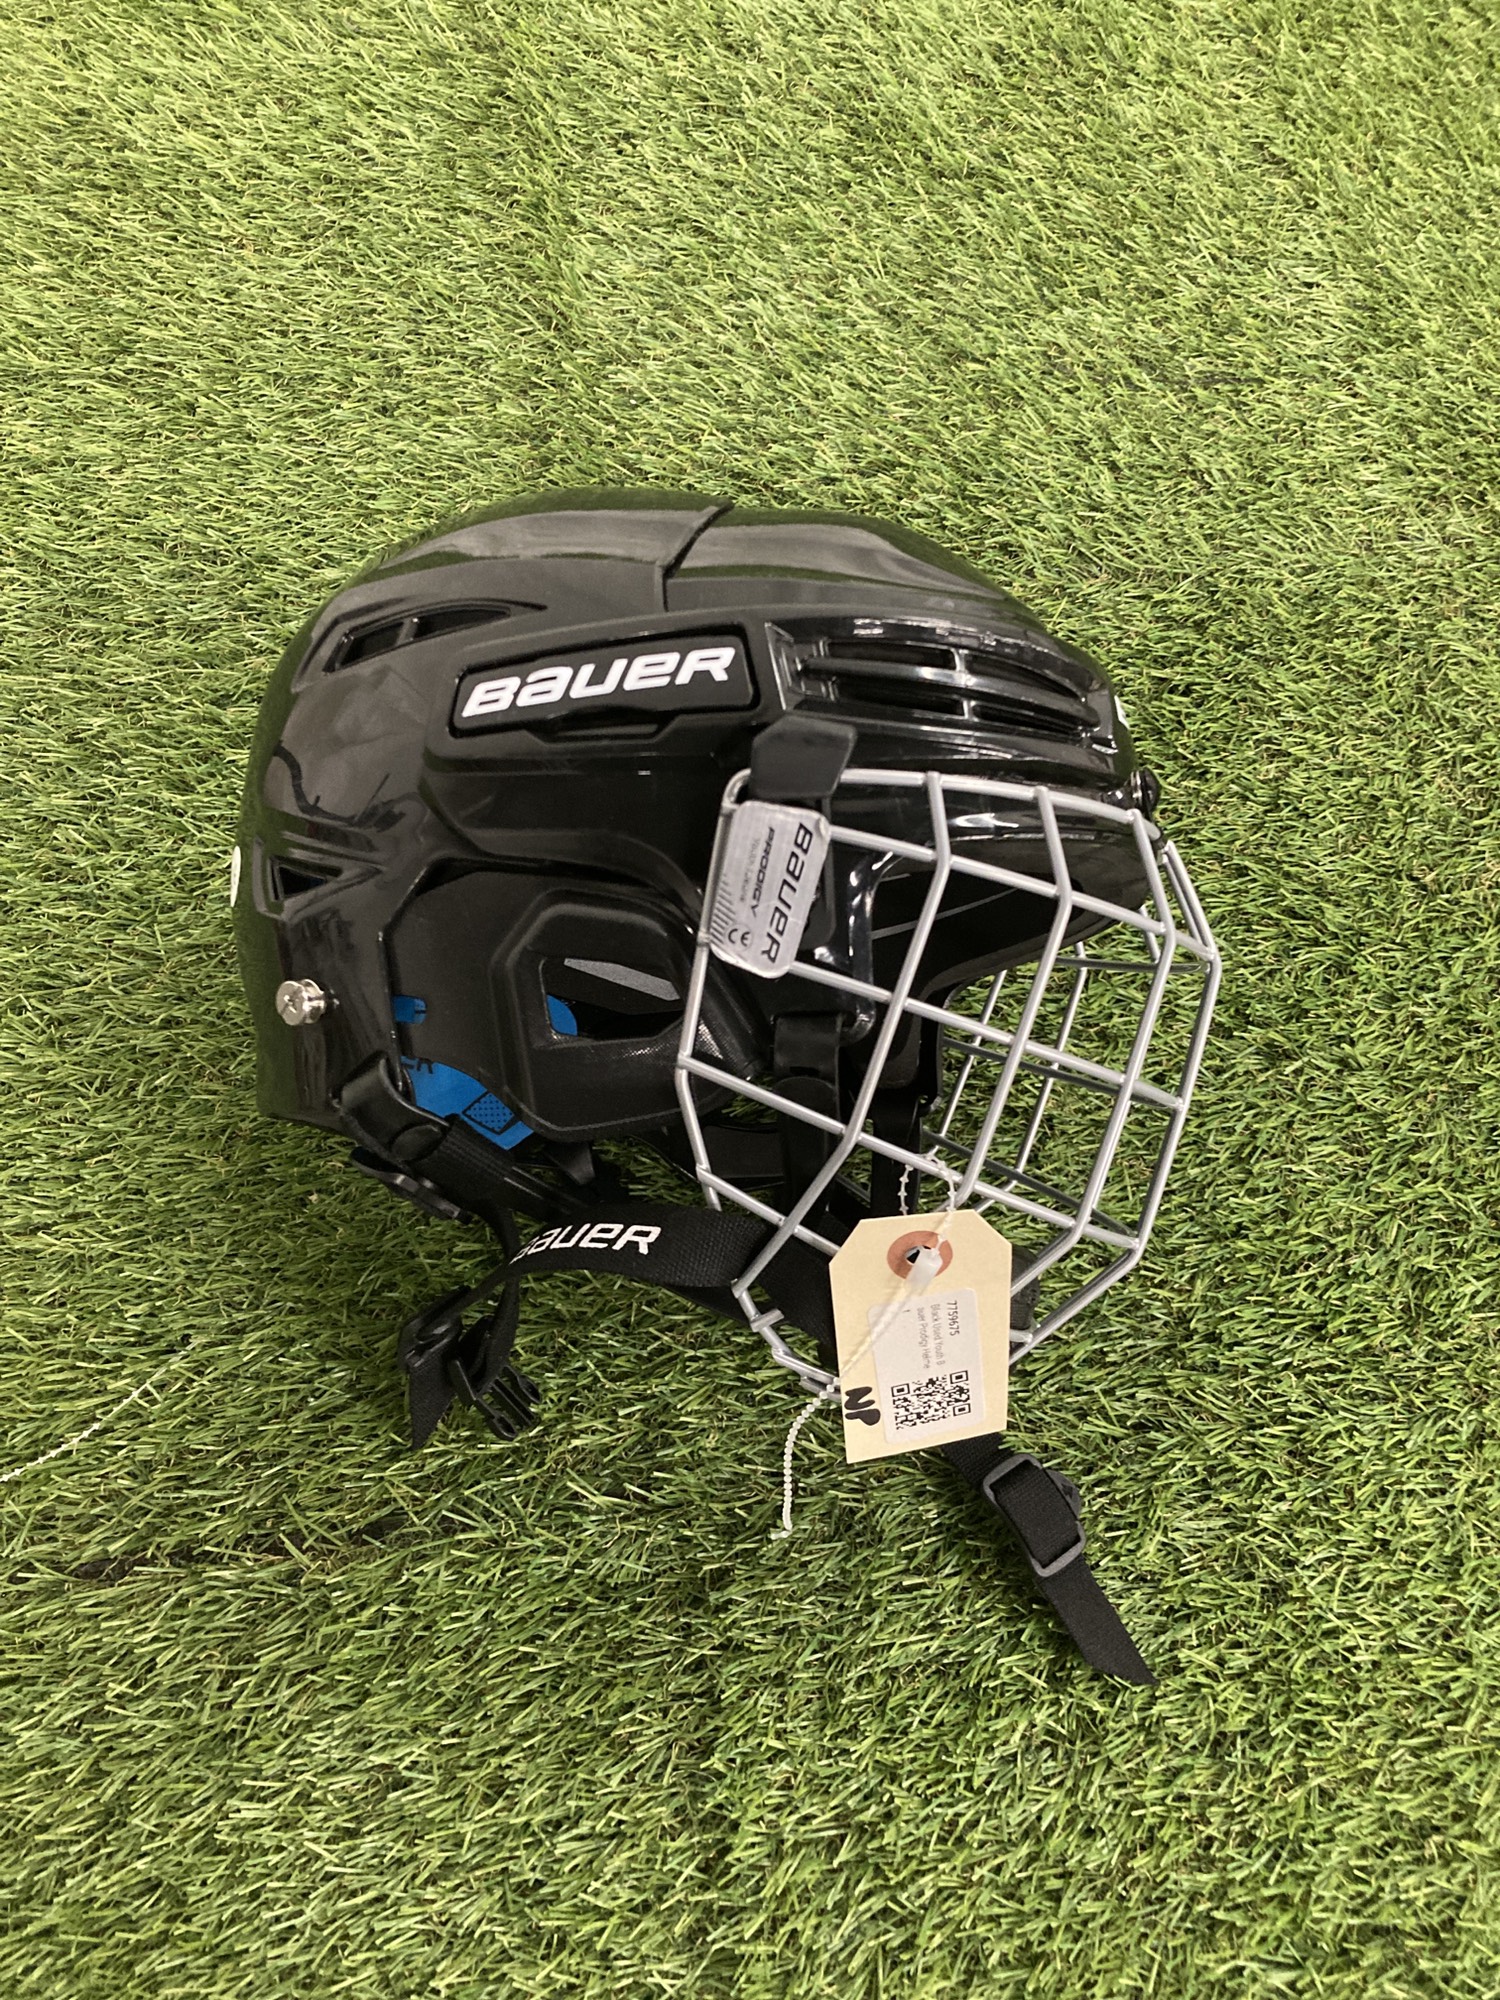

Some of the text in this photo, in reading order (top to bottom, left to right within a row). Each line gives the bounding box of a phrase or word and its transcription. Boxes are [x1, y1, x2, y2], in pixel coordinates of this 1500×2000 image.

[462, 647, 736, 717] BAUER
[751, 826, 775, 918] PRODIGY
[762, 822, 813, 963] BAUER
[930, 1303, 942, 1322] Black
[946, 1299, 960, 1336] 7759675
[919, 1322, 929, 1347] Prodigy
[932, 1323, 943, 1341] Used
[934, 1341, 945, 1361] Youth
